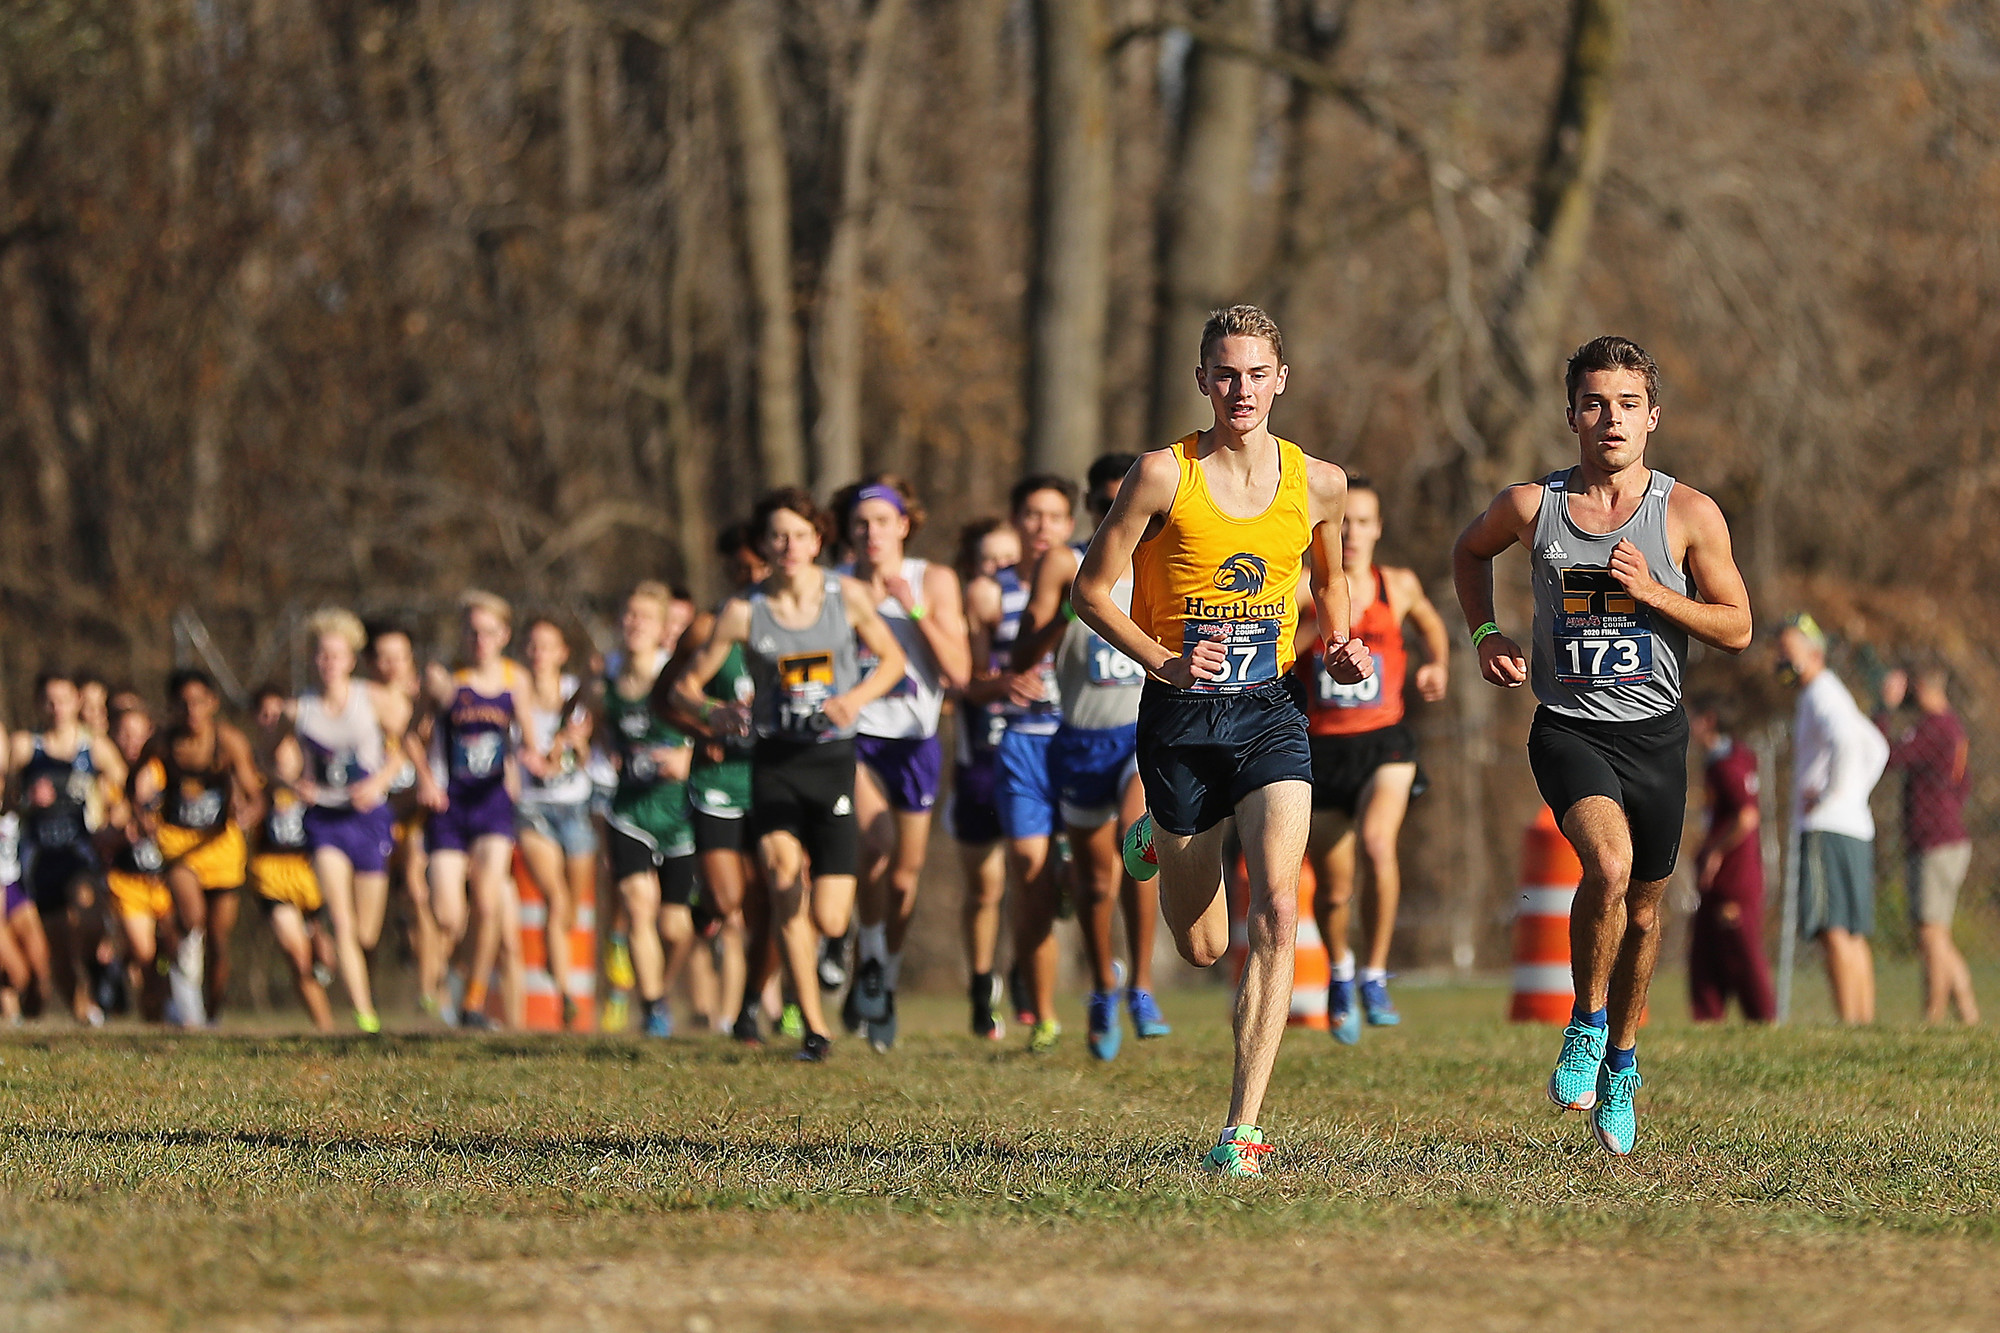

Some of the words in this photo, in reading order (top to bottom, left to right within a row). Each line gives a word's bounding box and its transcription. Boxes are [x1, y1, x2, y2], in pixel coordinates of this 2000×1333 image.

[1542, 552, 1568, 560] adidas
[1184, 596, 1286, 618] Hartland
[1234, 627, 1267, 636] COUNTRY
[1565, 639, 1641, 675] 173
